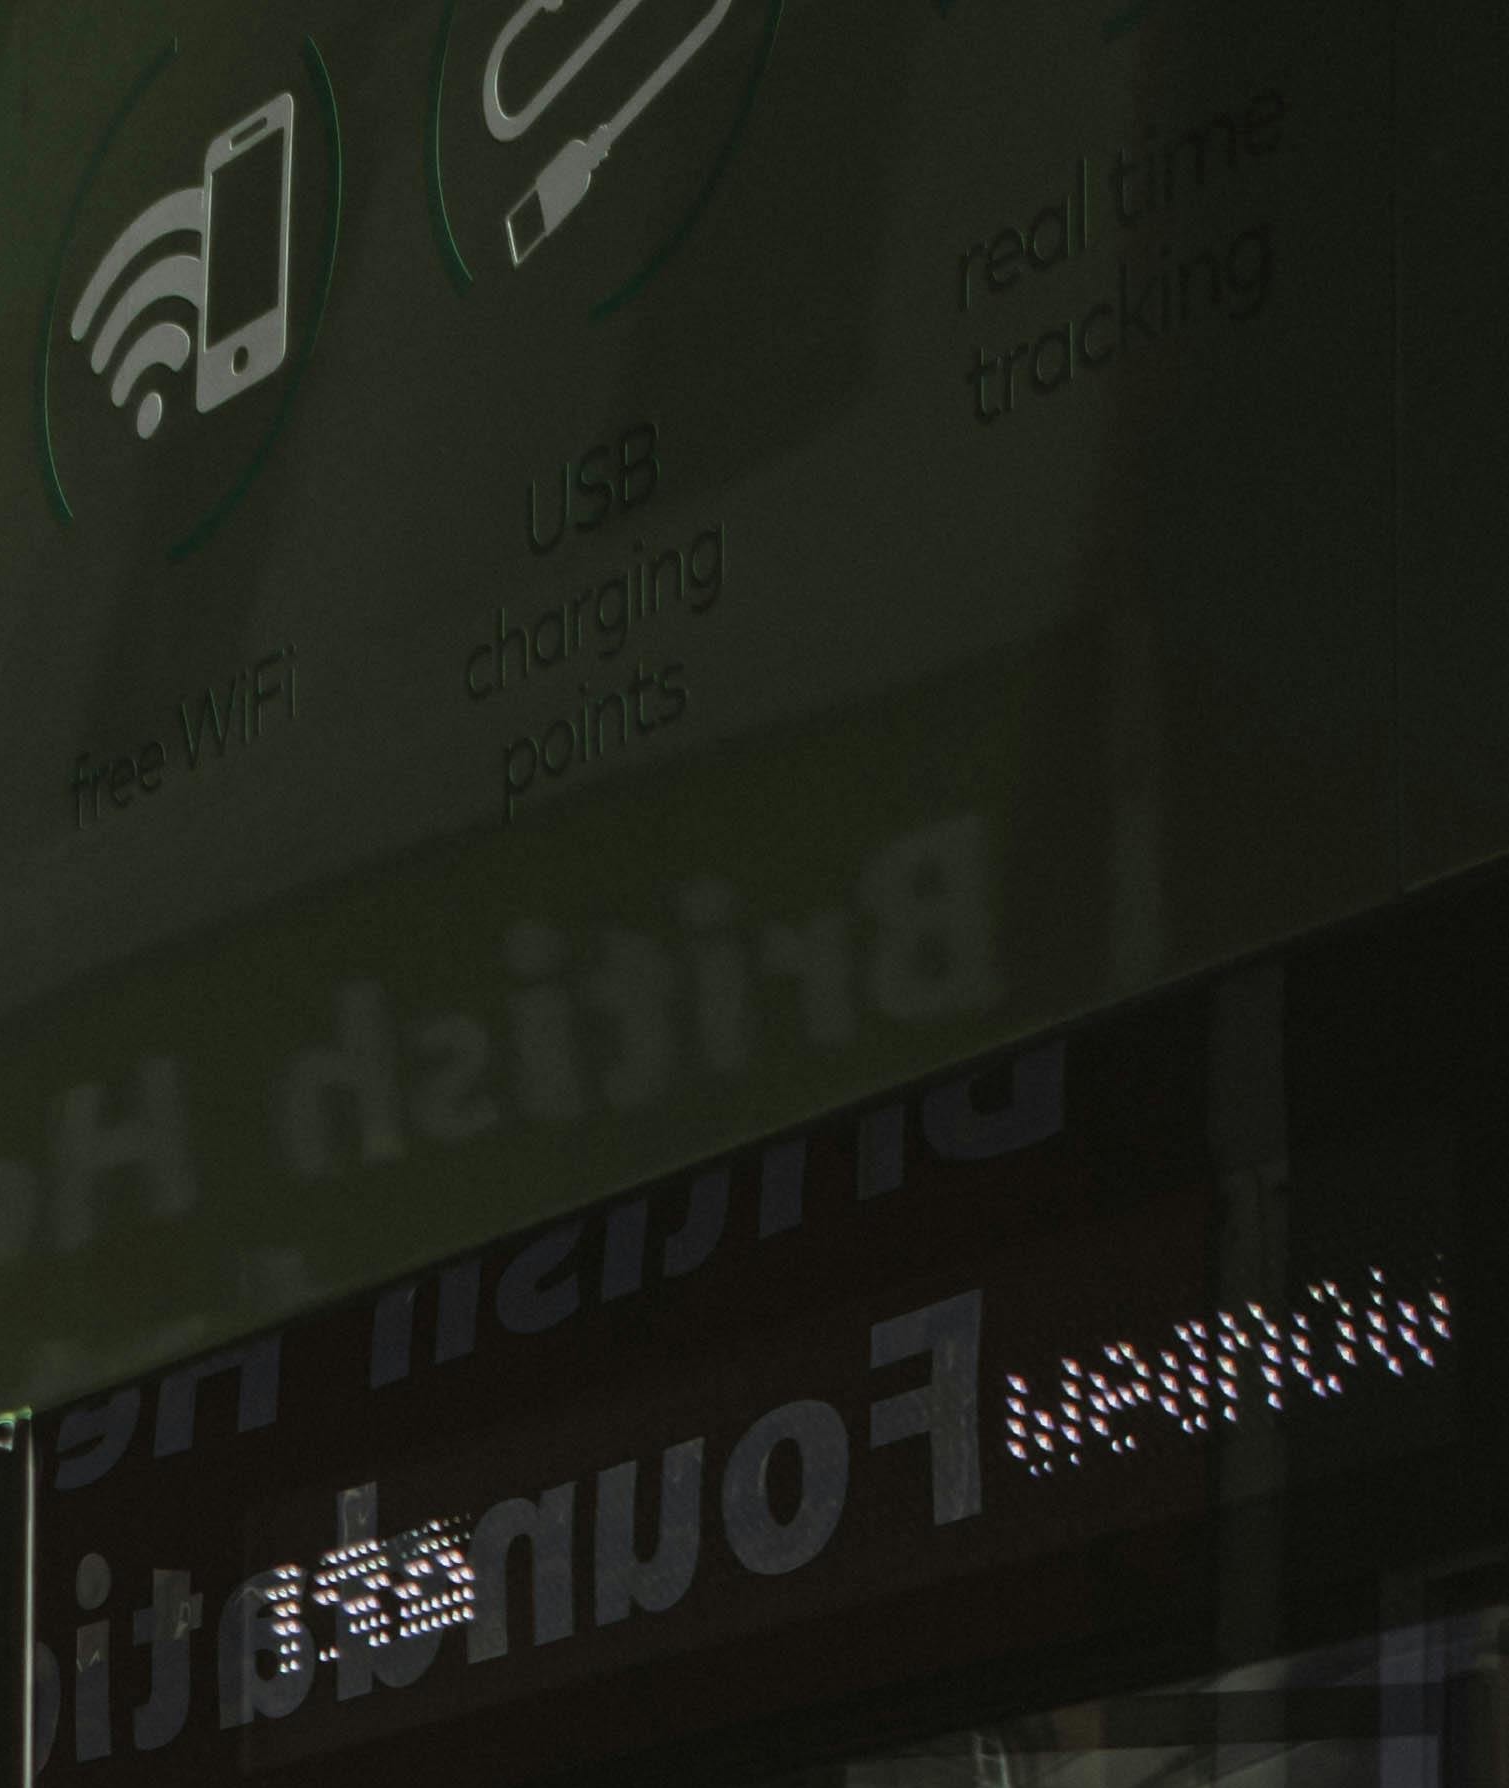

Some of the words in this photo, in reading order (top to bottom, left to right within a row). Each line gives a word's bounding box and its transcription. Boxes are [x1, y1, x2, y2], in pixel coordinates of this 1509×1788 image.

[956, 154, 1092, 314] real
[1109, 88, 1295, 230] time
[964, 221, 1278, 428] tracking
[524, 419, 662, 556] USB
[463, 522, 726, 704] charging
[67, 736, 167, 832] free
[179, 644, 299, 771] WiFi
[502, 661, 688, 823] points
